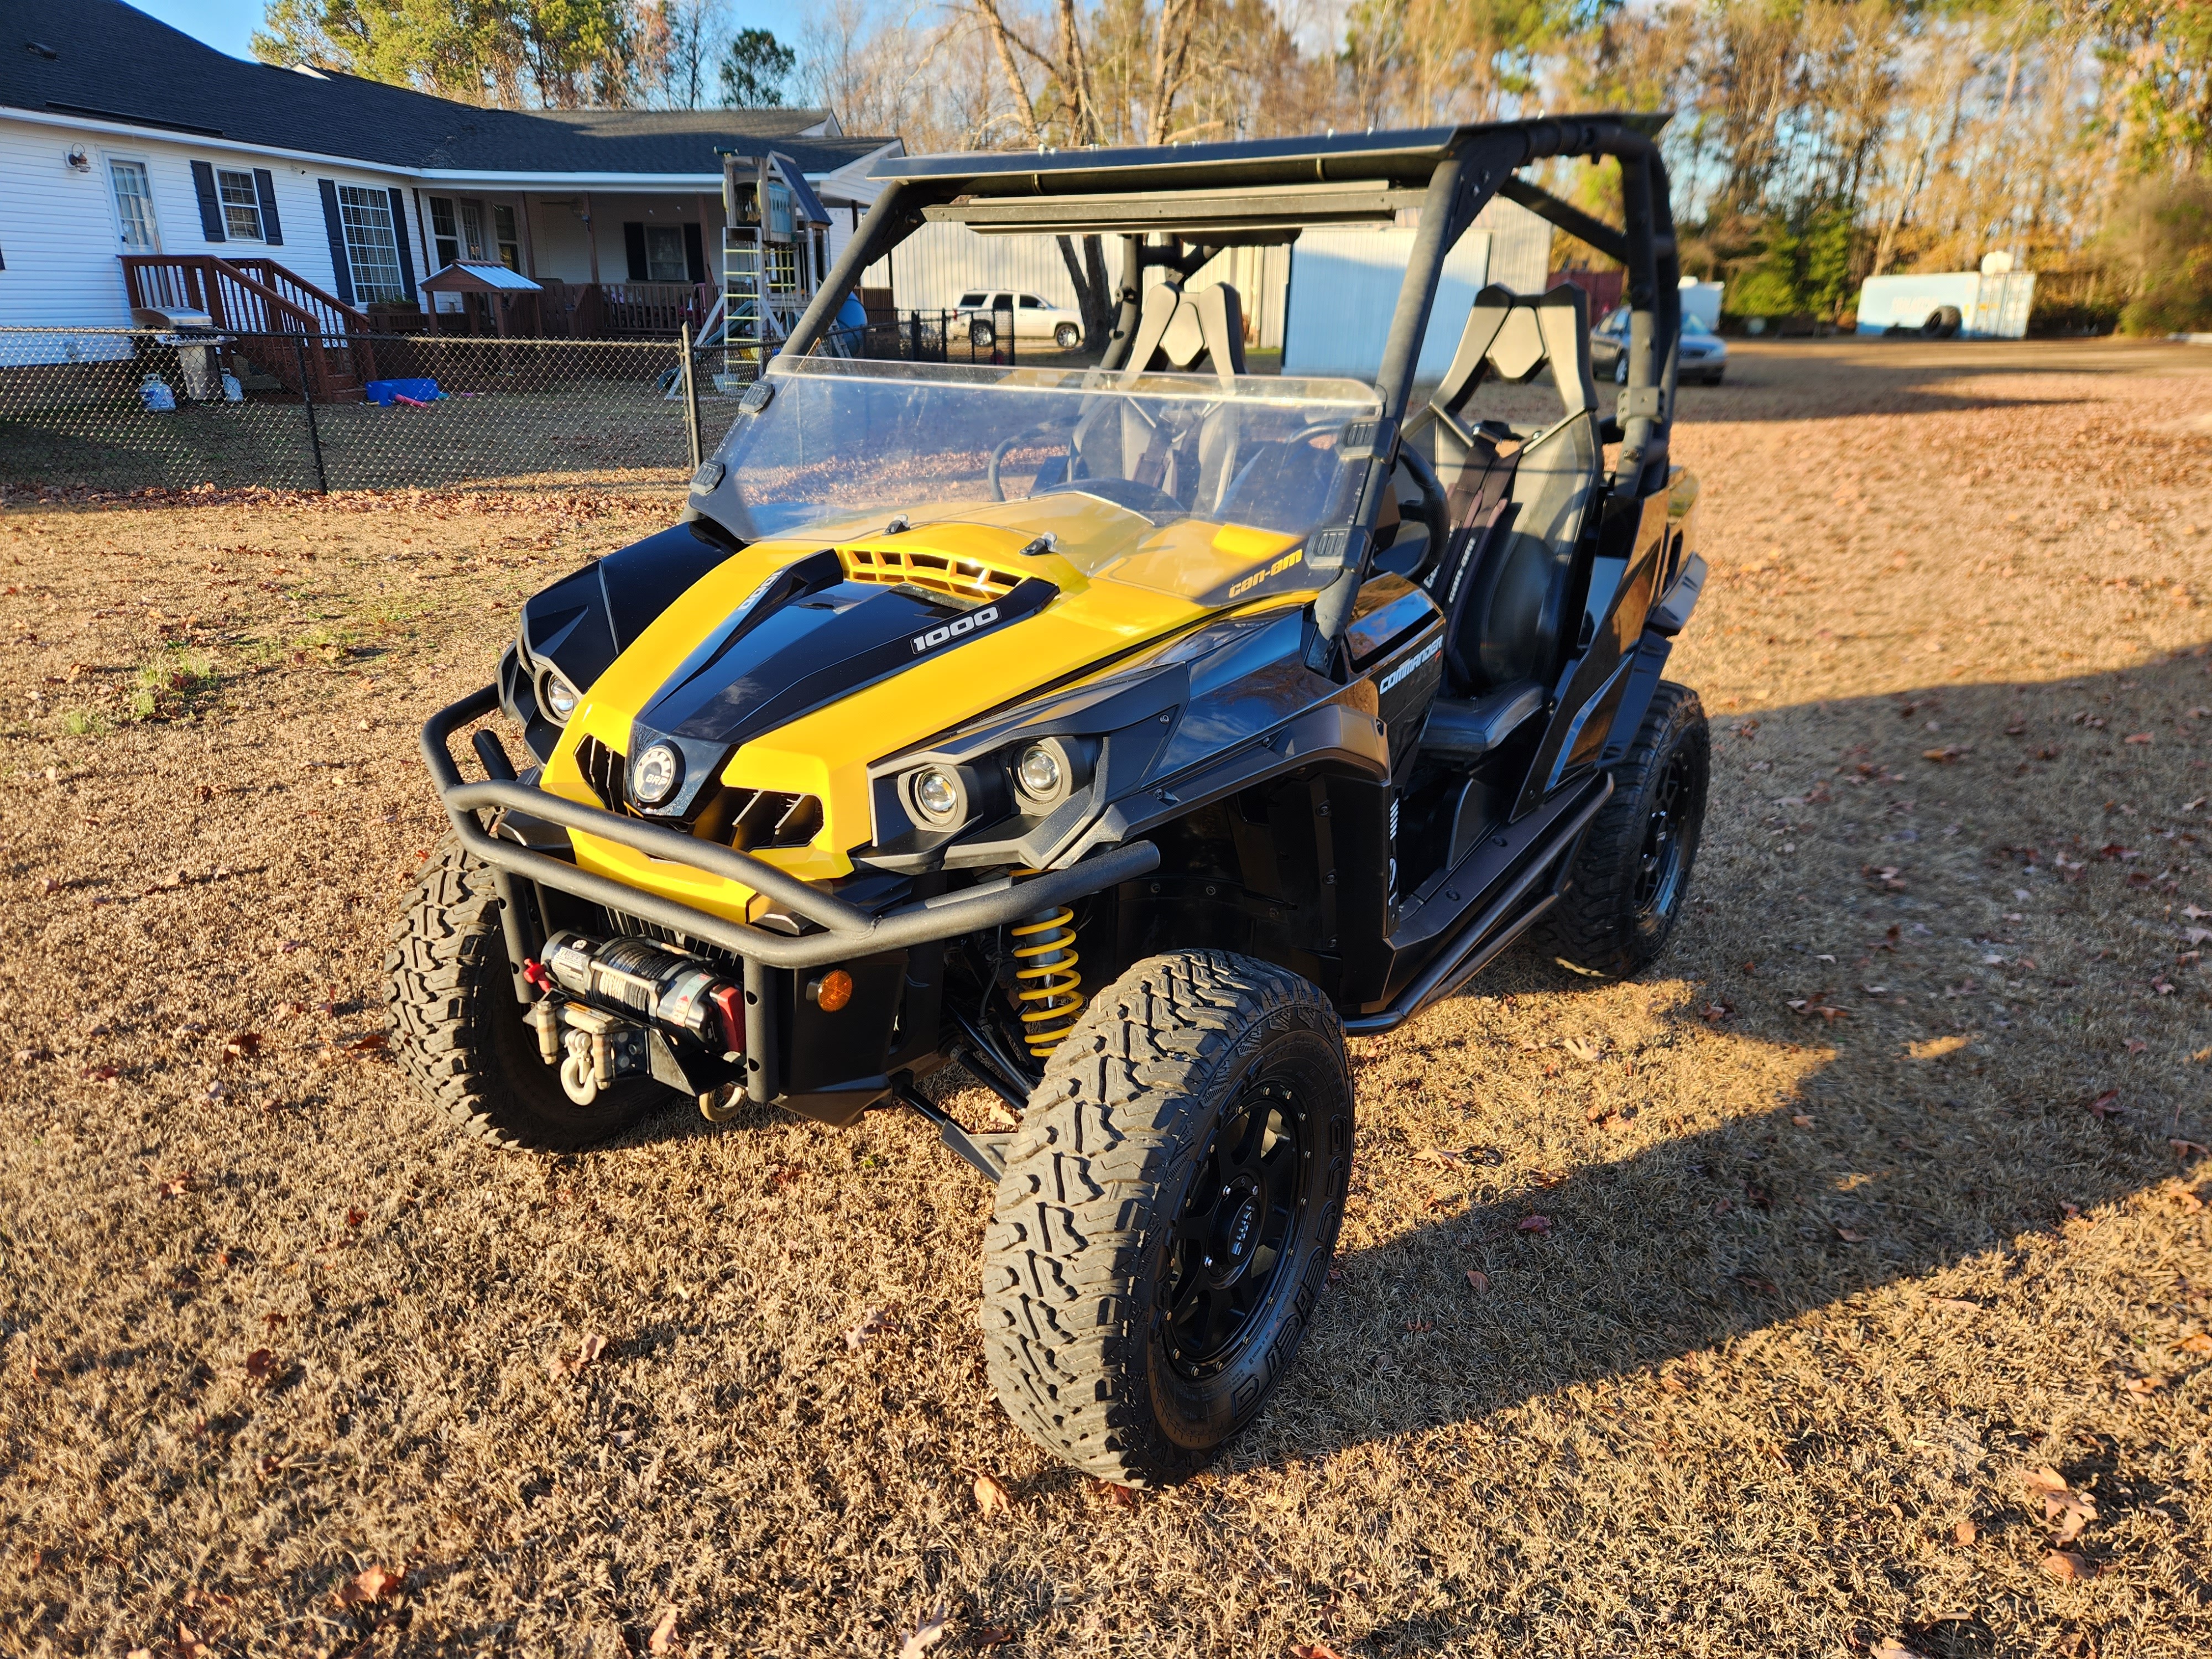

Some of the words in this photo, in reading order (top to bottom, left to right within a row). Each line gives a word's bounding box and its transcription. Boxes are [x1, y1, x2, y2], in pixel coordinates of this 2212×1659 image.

[737, 570, 784, 610] 1000
[1229, 549, 1303, 598] can-am
[914, 607, 998, 651] 1000
[1379, 634, 1444, 695] COMMANDER
[645, 773, 669, 785] BRP
